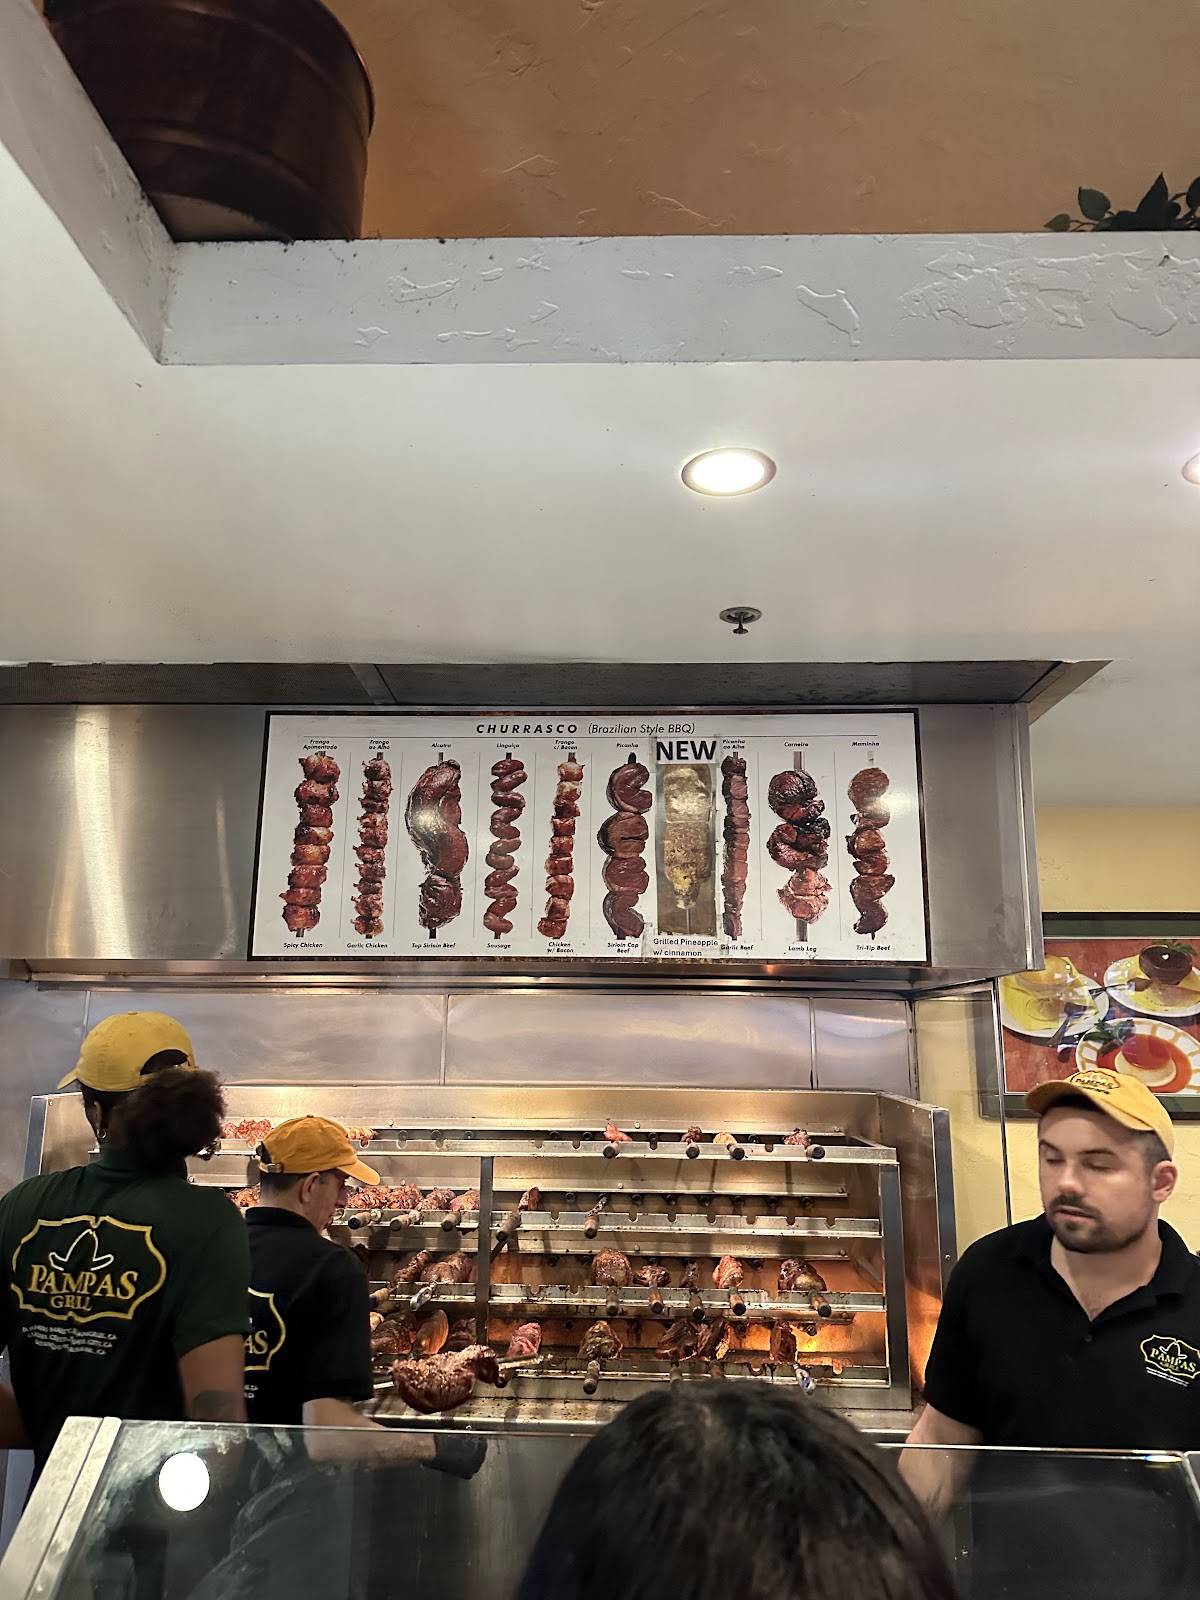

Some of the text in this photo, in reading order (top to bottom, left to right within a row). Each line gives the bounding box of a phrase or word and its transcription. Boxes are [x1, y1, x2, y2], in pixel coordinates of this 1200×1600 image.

[476, 723, 695, 736] CHURRASCO (Brazilian Style BBQ)
[656, 740, 717, 761] NEW
[680, 938, 719, 946] Pineapple
[28, 1264, 139, 1300] PAMPAS
[1150, 1348, 1196, 1372] PAMPAS
